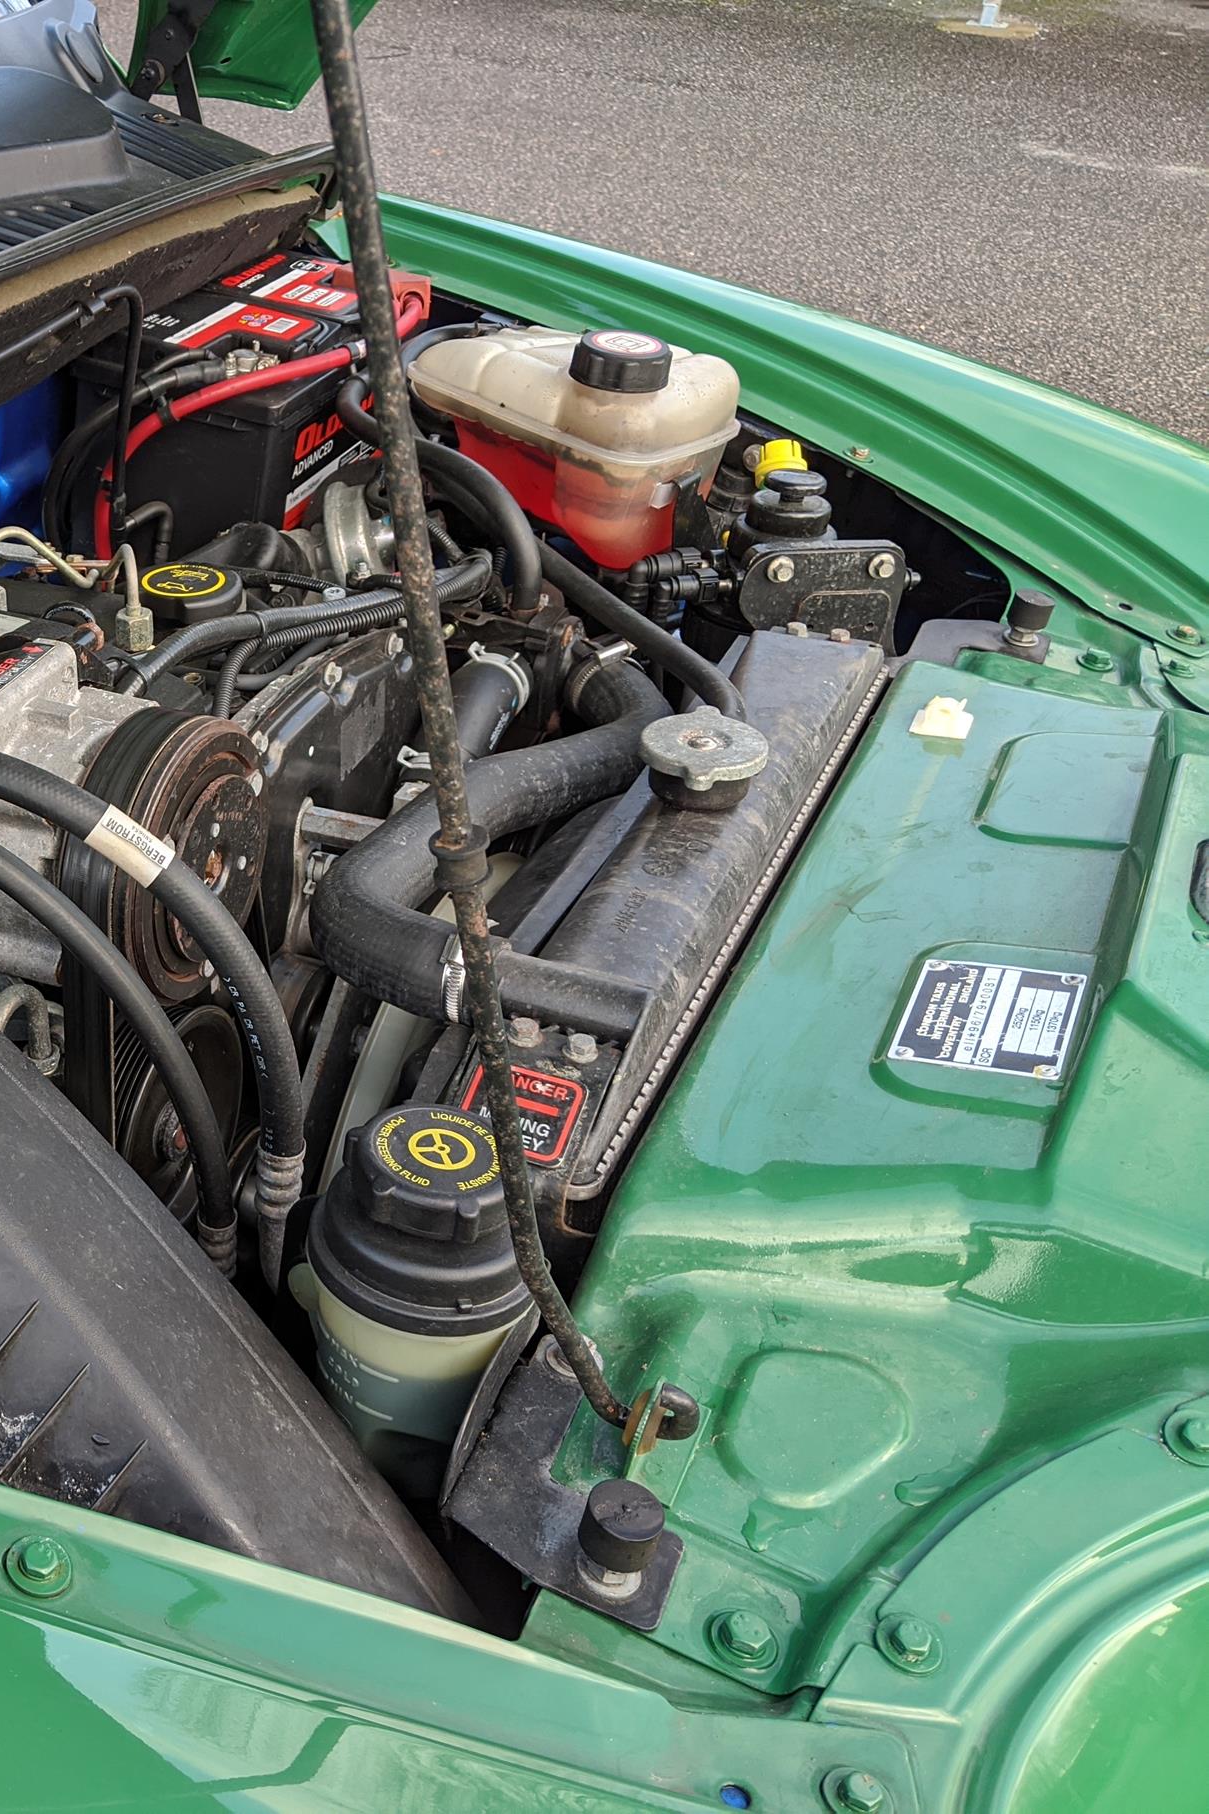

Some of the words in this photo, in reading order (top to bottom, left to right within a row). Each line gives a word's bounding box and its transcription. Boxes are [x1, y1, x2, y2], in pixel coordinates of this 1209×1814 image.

[291, 439, 334, 480] ADVANCED
[105, 817, 167, 865] BERGSTROM
[916, 1002, 939, 1036] LONDON
[930, 981, 947, 1002] TAXIS
[930, 981, 962, 1040] INTERNATIONAL
[939, 1015, 963, 1058] COVENTRY
[958, 968, 979, 1003] ENGLAND
[1029, 1009, 1045, 1031] 1150kg
[1046, 1011, 1062, 1033] 1370kg
[978, 1047, 993, 1064] SCR
[378, 1115, 407, 1138] POWER
[430, 1111, 475, 1129] LIQUIDE
[472, 1125, 489, 1136] DE
[376, 1136, 403, 1172] STEERING
[399, 1169, 431, 1187] FLUID
